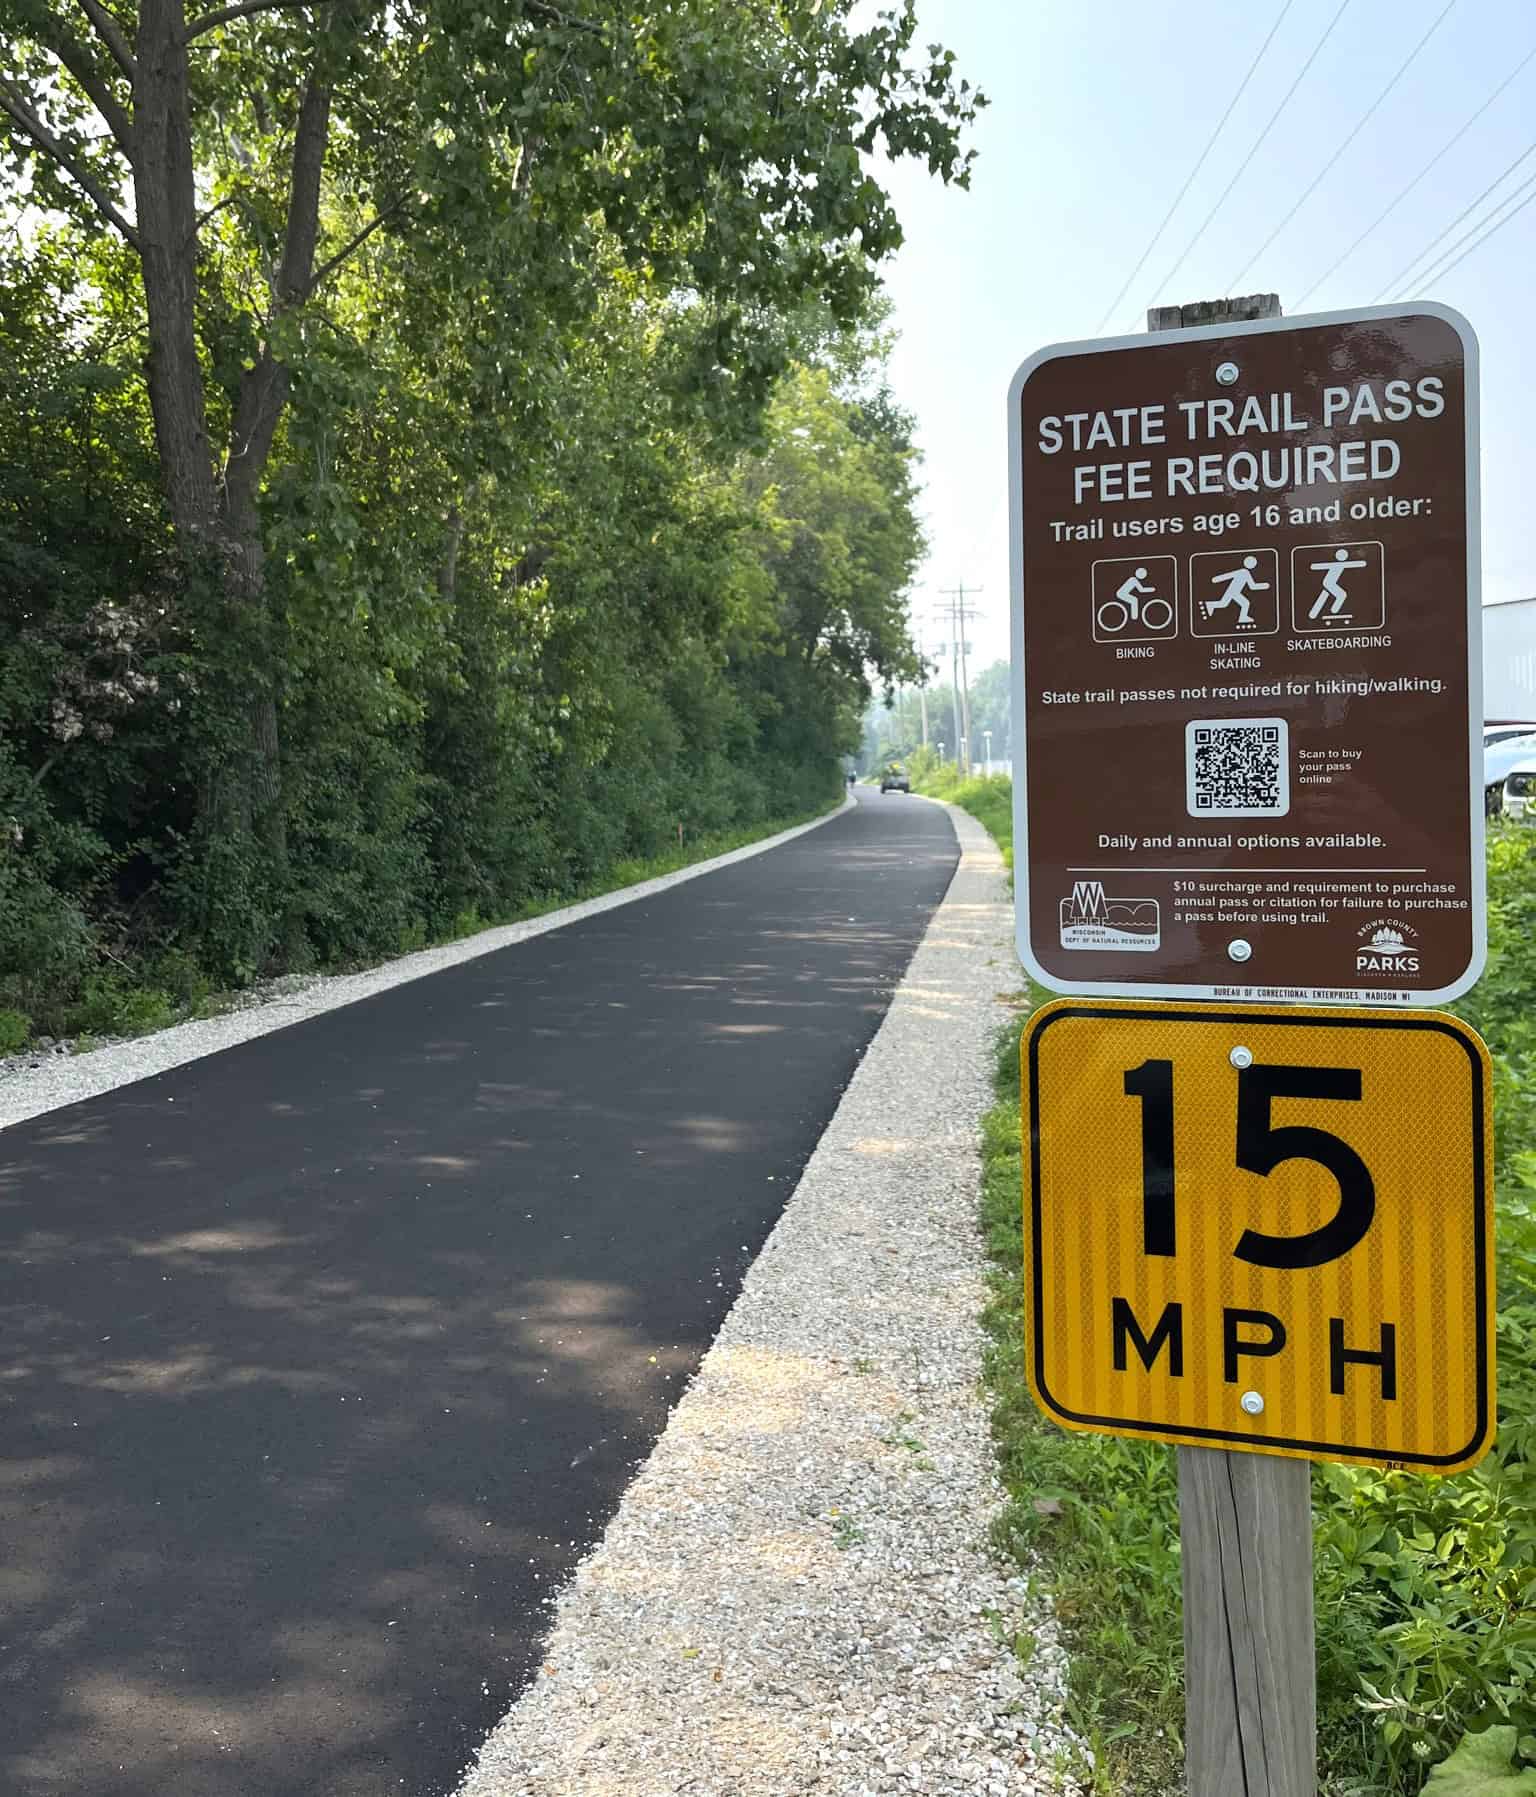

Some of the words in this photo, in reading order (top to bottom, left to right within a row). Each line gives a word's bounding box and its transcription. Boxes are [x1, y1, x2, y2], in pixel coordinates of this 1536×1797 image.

[1038, 404, 1166, 454] STATE
[1179, 392, 1307, 441] TRAIL
[1323, 376, 1445, 427] PASS
[1073, 460, 1153, 504] FEE
[1167, 438, 1401, 497] REQUIRED
[1050, 518, 1103, 542] Trail
[1112, 514, 1184, 538] users
[1193, 509, 1240, 535] age
[1250, 505, 1280, 528] 16
[1289, 498, 1341, 526] and
[1350, 496, 1432, 520] older:
[1214, 641, 1256, 655] IN-LINE
[1287, 635, 1392, 652] SKATEBOARDING
[1116, 646, 1155, 660] BIKING
[1210, 657, 1261, 670] SKATING
[1042, 691, 1081, 704] State
[1085, 689, 1114, 703] trail
[1120, 688, 1175, 704] passes
[1181, 686, 1207, 699] not
[1212, 682, 1281, 700] required
[1286, 682, 1310, 695] for
[1315, 677, 1447, 696] hiking/walking.
[1299, 749, 1325, 759] Scan
[1328, 749, 1339, 758] to
[1342, 748, 1362, 760] buy
[1299, 763, 1324, 774] your
[1326, 763, 1352, 773] pass
[1299, 775, 1332, 784] online
[1098, 834, 1137, 850] Daily
[1142, 834, 1172, 848] and
[1177, 834, 1232, 848] annual
[1237, 834, 1300, 850] options
[1305, 833, 1387, 848] available.
[1173, 880, 1195, 892] $10
[1199, 881, 1262, 894] surcharge
[1266, 881, 1289, 892] and
[1293, 882, 1372, 895] requirement
[1376, 882, 1389, 893] to
[1393, 882, 1456, 895] purchase
[1174, 896, 1216, 907] annual
[1219, 898, 1249, 909] pass
[1252, 898, 1266, 907] or
[1269, 896, 1317, 907] citation
[1320, 897, 1339, 908] for
[1342, 897, 1384, 908] failure
[1388, 898, 1401, 908] to
[1404, 898, 1468, 910] purchase
[1174, 912, 1182, 921] a
[1185, 913, 1214, 924] pass
[1218, 911, 1258, 922] before
[1262, 912, 1297, 925] using
[1301, 912, 1329, 923] trail.
[1357, 919, 1385, 937] BROWN
[1386, 918, 1419, 938] COUNTY
[1356, 956, 1420, 971] PARKS
[1214, 987, 1240, 997] BUREAU
[1244, 988, 1252, 997] OF
[1257, 988, 1308, 998] CORRECTIONAL
[1365, 991, 1397, 1001] MADISON
[1402, 992, 1410, 1001] WI
[1123, 1059, 1376, 1270] 15
